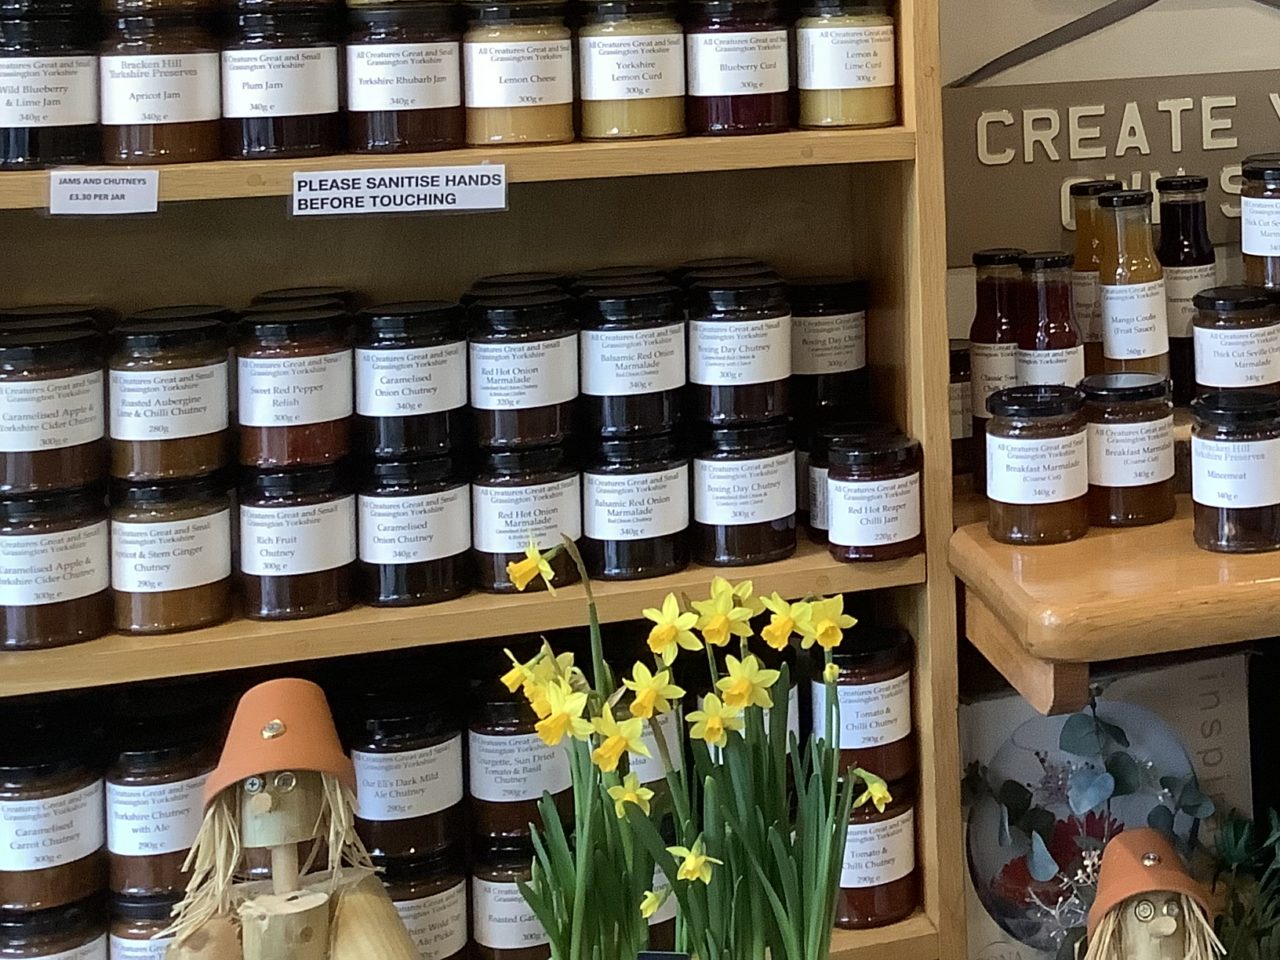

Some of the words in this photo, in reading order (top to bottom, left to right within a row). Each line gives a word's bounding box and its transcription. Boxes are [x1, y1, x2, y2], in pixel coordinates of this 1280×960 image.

[616, 62, 656, 70] Yorkshire
[720, 63, 757, 72] Blueberry
[152, 68, 197, 78] Preserves
[612, 73, 639, 81] Lemon
[642, 72, 662, 80] Curd
[396, 75, 432, 85] Rhubarb
[499, 76, 528, 84] Lemon
[530, 75, 556, 83] Cheese
[23, 84, 68, 95] Blueberry
[242, 81, 262, 90] Plum
[265, 81, 283, 90] Jam
[129, 92, 159, 101] Apricot
[160, 91, 180, 99] Jam
[16, 98, 40, 107] Lime
[43, 98, 61, 106] Jam
[975, 96, 1238, 165] CREATE
[104, 178, 146, 186] CHUTNEYS
[298, 178, 361, 191] PLEASE
[366, 176, 440, 189] SANITISE
[446, 174, 501, 187] HANDS
[298, 196, 364, 210] BEFORE
[370, 193, 456, 207] TOUCHING
[720, 346, 736, 354] Day
[638, 352, 652, 360] Red
[615, 360, 660, 370] Marmalade
[512, 366, 538, 375] Onion
[380, 374, 431, 384] Caramelised
[486, 375, 532, 384] Marmalade
[293, 384, 323, 394] Pepper
[401, 386, 438, 397] Chutney
[155, 395, 201, 407] Aubergine
[143, 407, 168, 418] Chilli
[1006, 464, 1041, 473] Breakfast
[1043, 461, 1080, 472] Marmalade
[607, 507, 653, 516] Marmalade
[848, 506, 862, 514] Red
[864, 505, 880, 513] Hot
[882, 502, 906, 514] Reaper
[498, 511, 513, 519] Red
[536, 508, 558, 517] Onion
[377, 522, 428, 532] Caramelised
[172, 546, 203, 557] Ginger
[855, 709, 884, 719] Tomato
